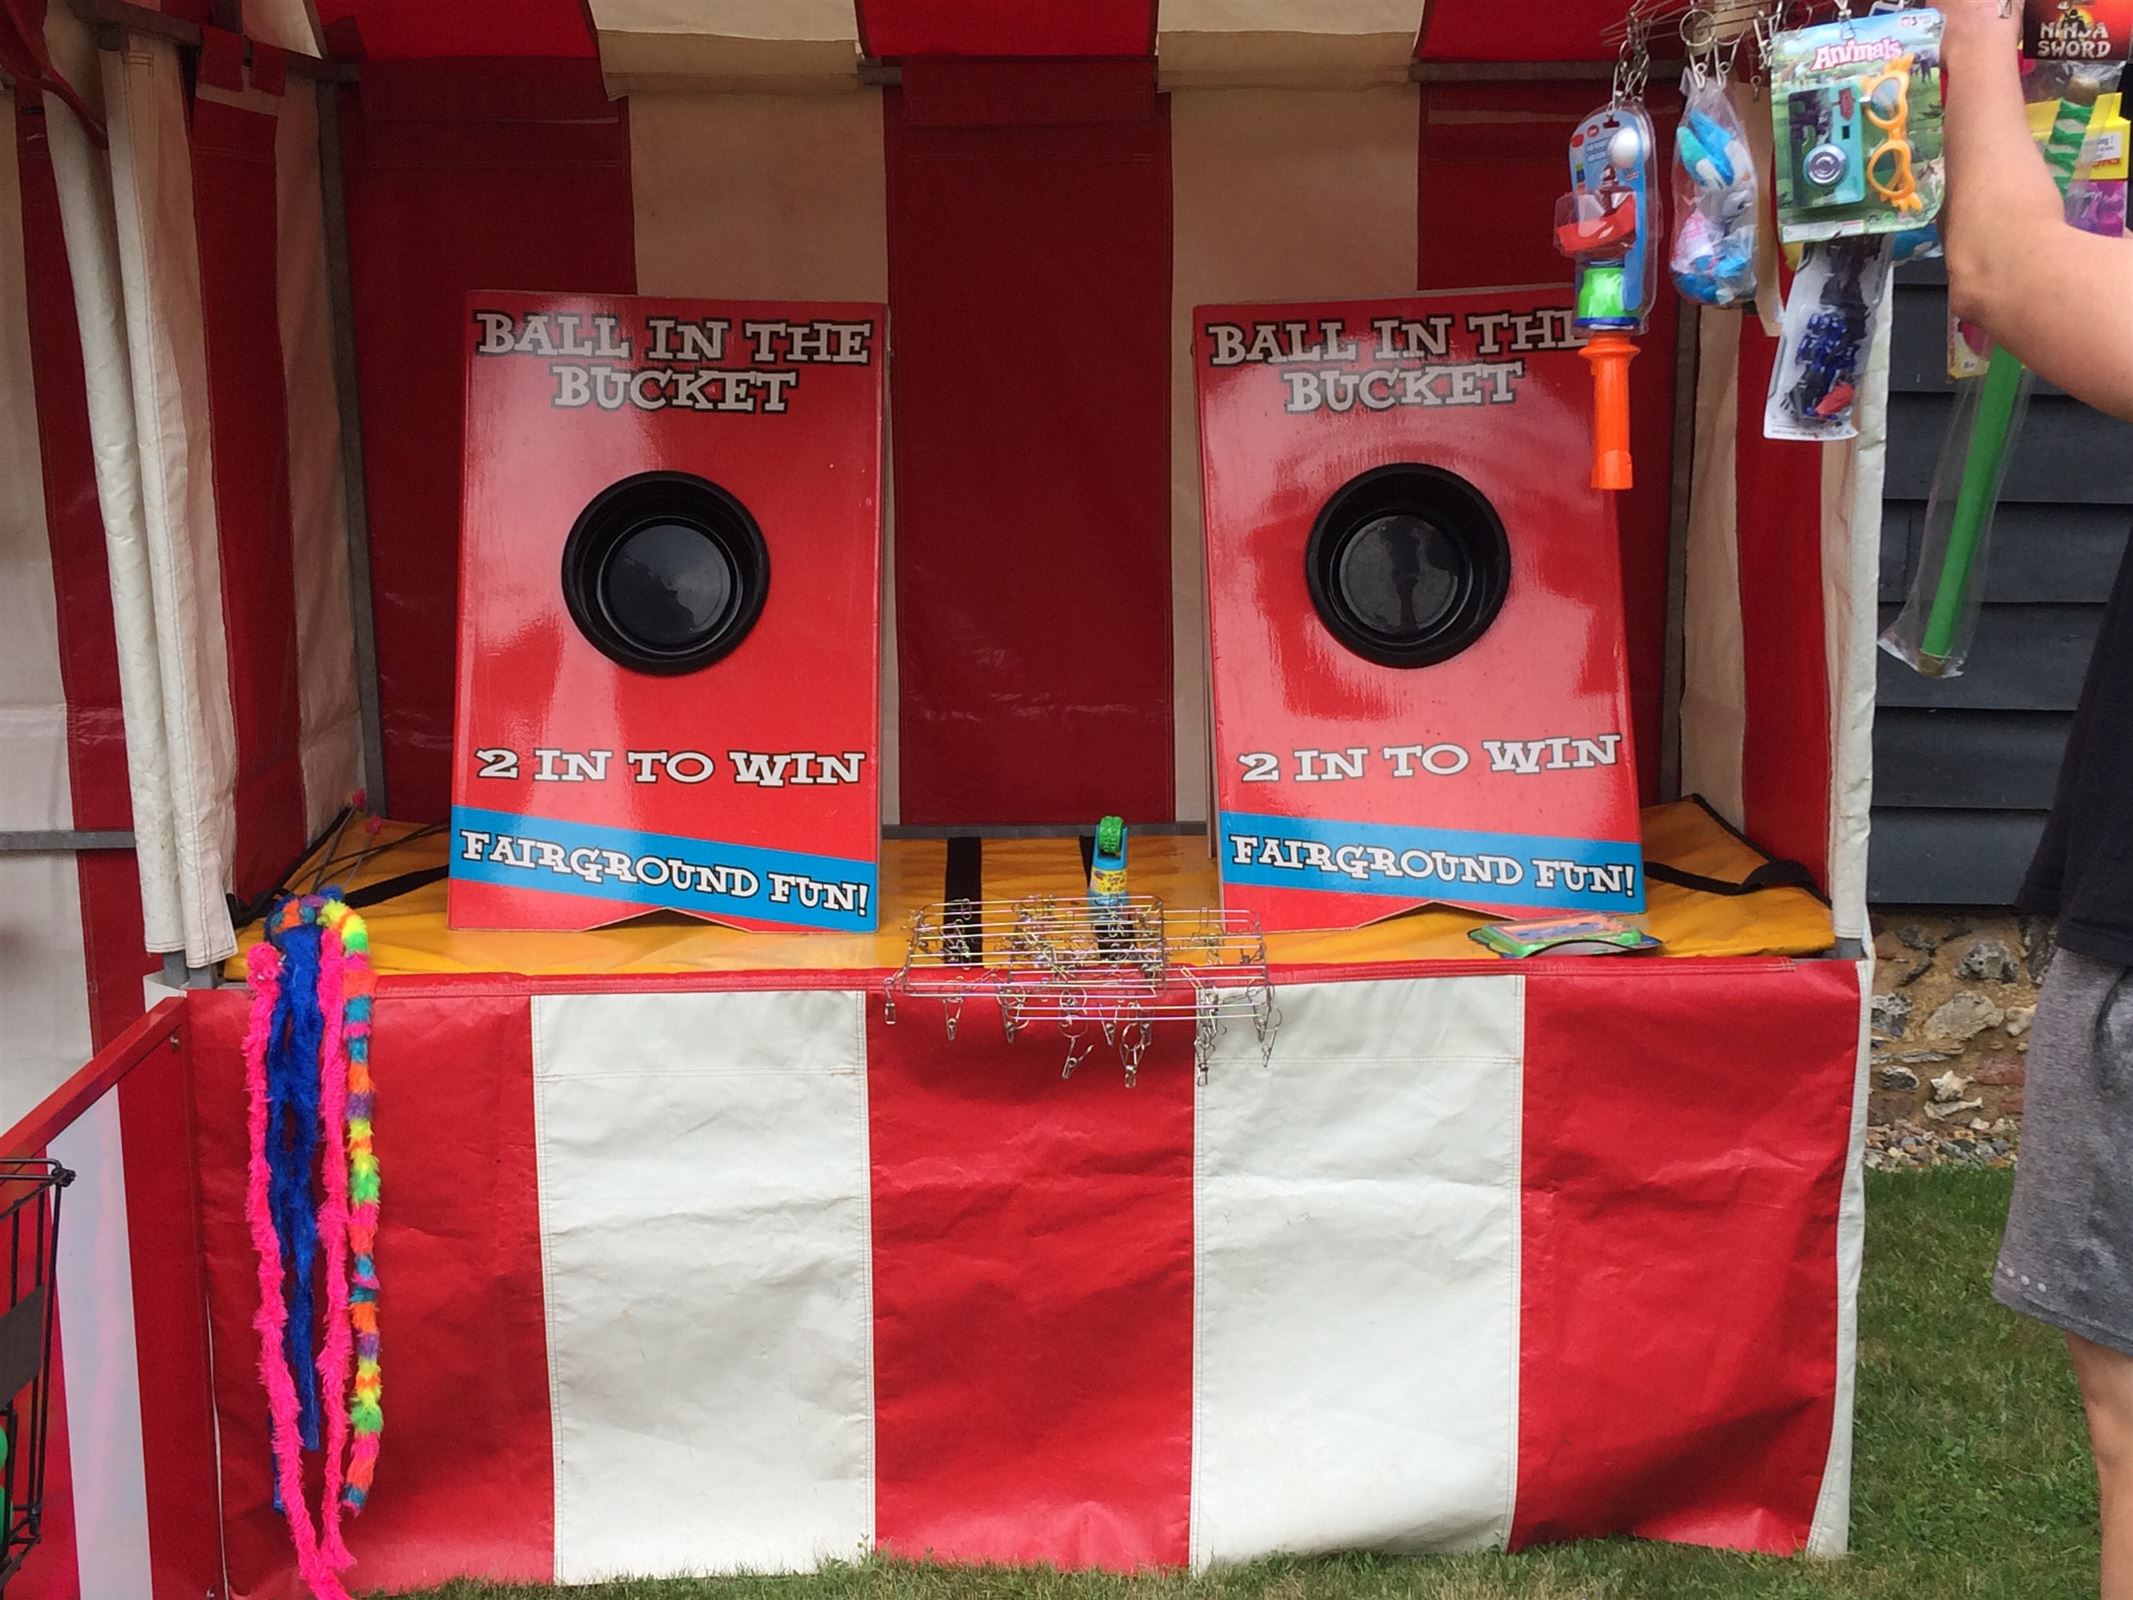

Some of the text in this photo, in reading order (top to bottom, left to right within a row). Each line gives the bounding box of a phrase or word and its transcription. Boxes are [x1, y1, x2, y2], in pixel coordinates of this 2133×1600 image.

[1811, 37, 1905, 72] Animals
[2037, 40, 2111, 59] SWORD
[2039, 22, 2109, 41] NINJA
[475, 311, 873, 365] BALL IN THE
[1206, 321, 1358, 367] BALL
[1371, 316, 1454, 360] IN
[549, 364, 798, 413] BUCKET
[1281, 360, 1524, 414] BUCKET
[475, 748, 867, 787] 2 IN TO WIN
[1237, 733, 1623, 783] 2 IN TO WIN
[459, 829, 870, 916] FAIRGROUND FUN!
[1229, 834, 1637, 899] FAIRGROUND FUN!
